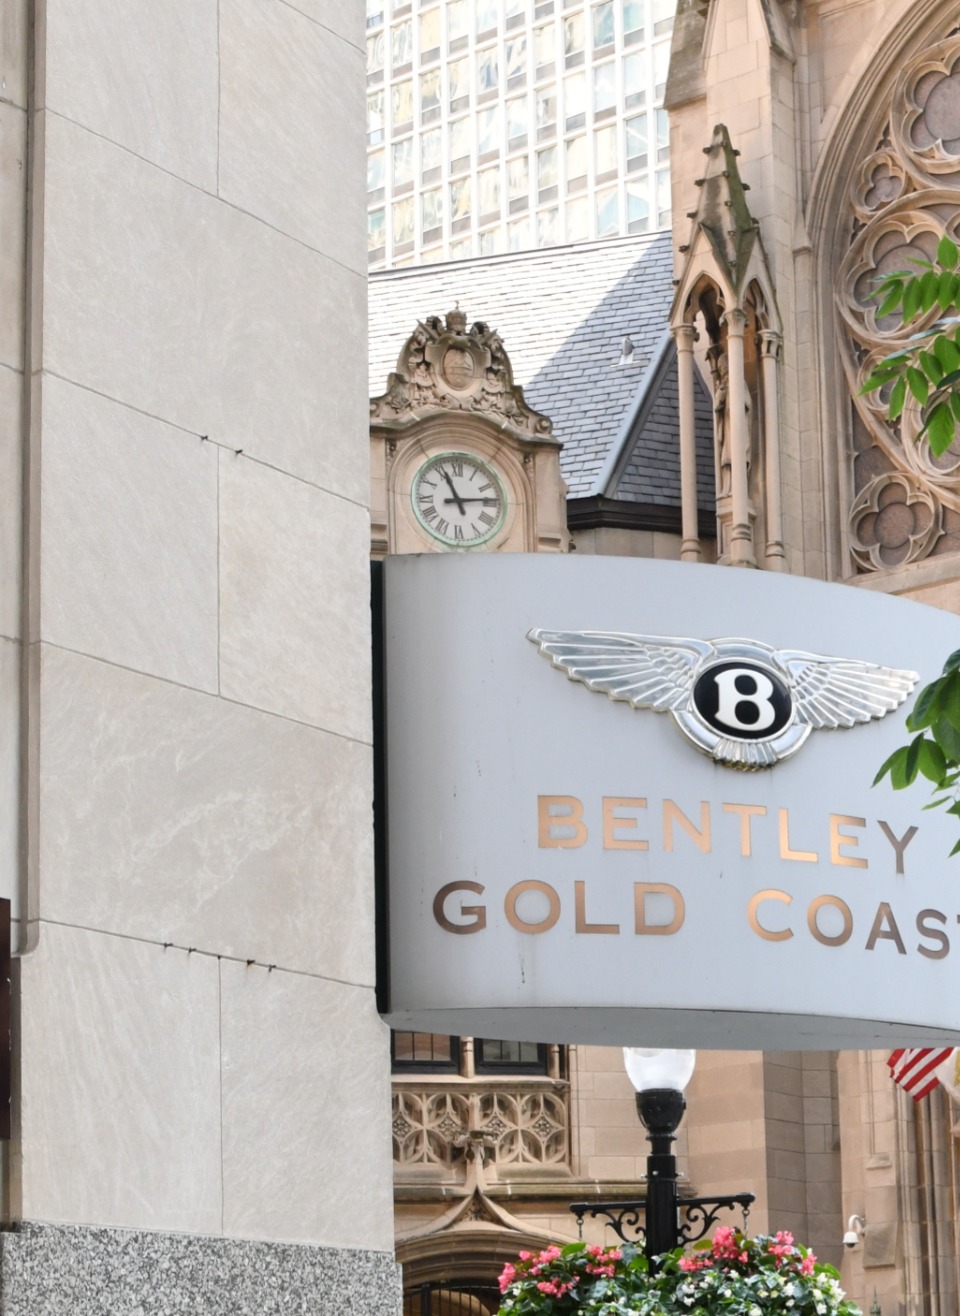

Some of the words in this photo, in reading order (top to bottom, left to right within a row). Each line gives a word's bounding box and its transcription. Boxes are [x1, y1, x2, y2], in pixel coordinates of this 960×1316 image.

[714, 668, 777, 732] B
[536, 795, 919, 875] BENTLEY
[432, 879, 686, 936] GOLD
